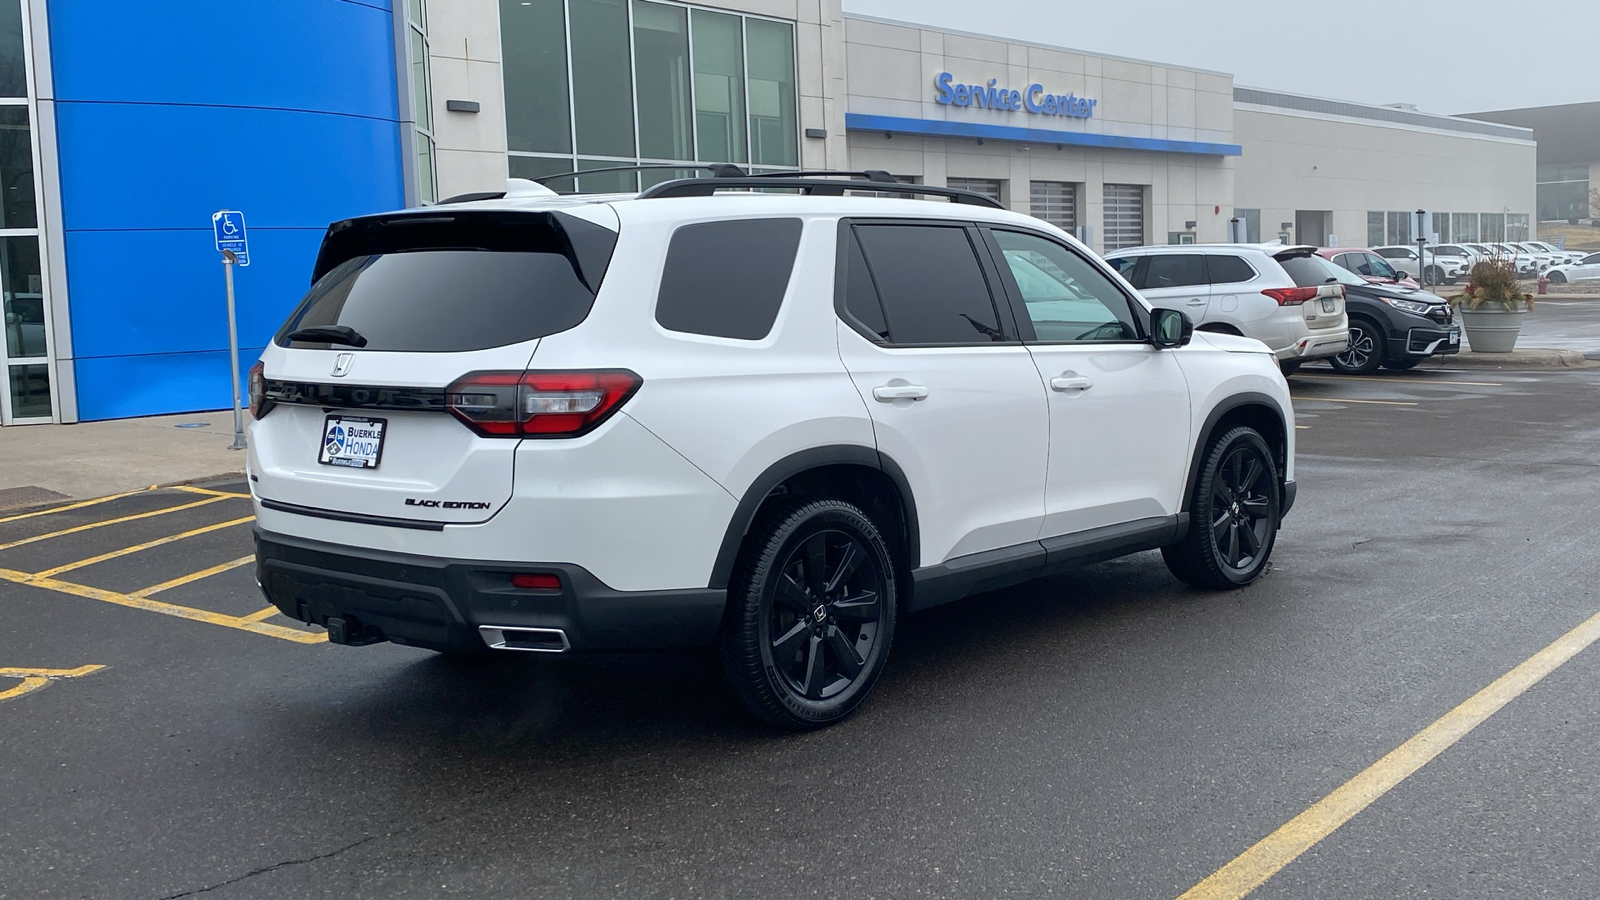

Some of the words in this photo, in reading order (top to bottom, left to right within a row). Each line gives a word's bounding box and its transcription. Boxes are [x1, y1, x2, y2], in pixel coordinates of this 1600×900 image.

[935, 72, 1021, 111] Service
[1024, 84, 1097, 118] Center
[285, 386, 399, 403] PILOT
[348, 427, 381, 439] BUERKLE
[344, 438, 378, 456] HONDA
[405, 499, 441, 508] BLACK
[443, 501, 491, 509] EDITION
